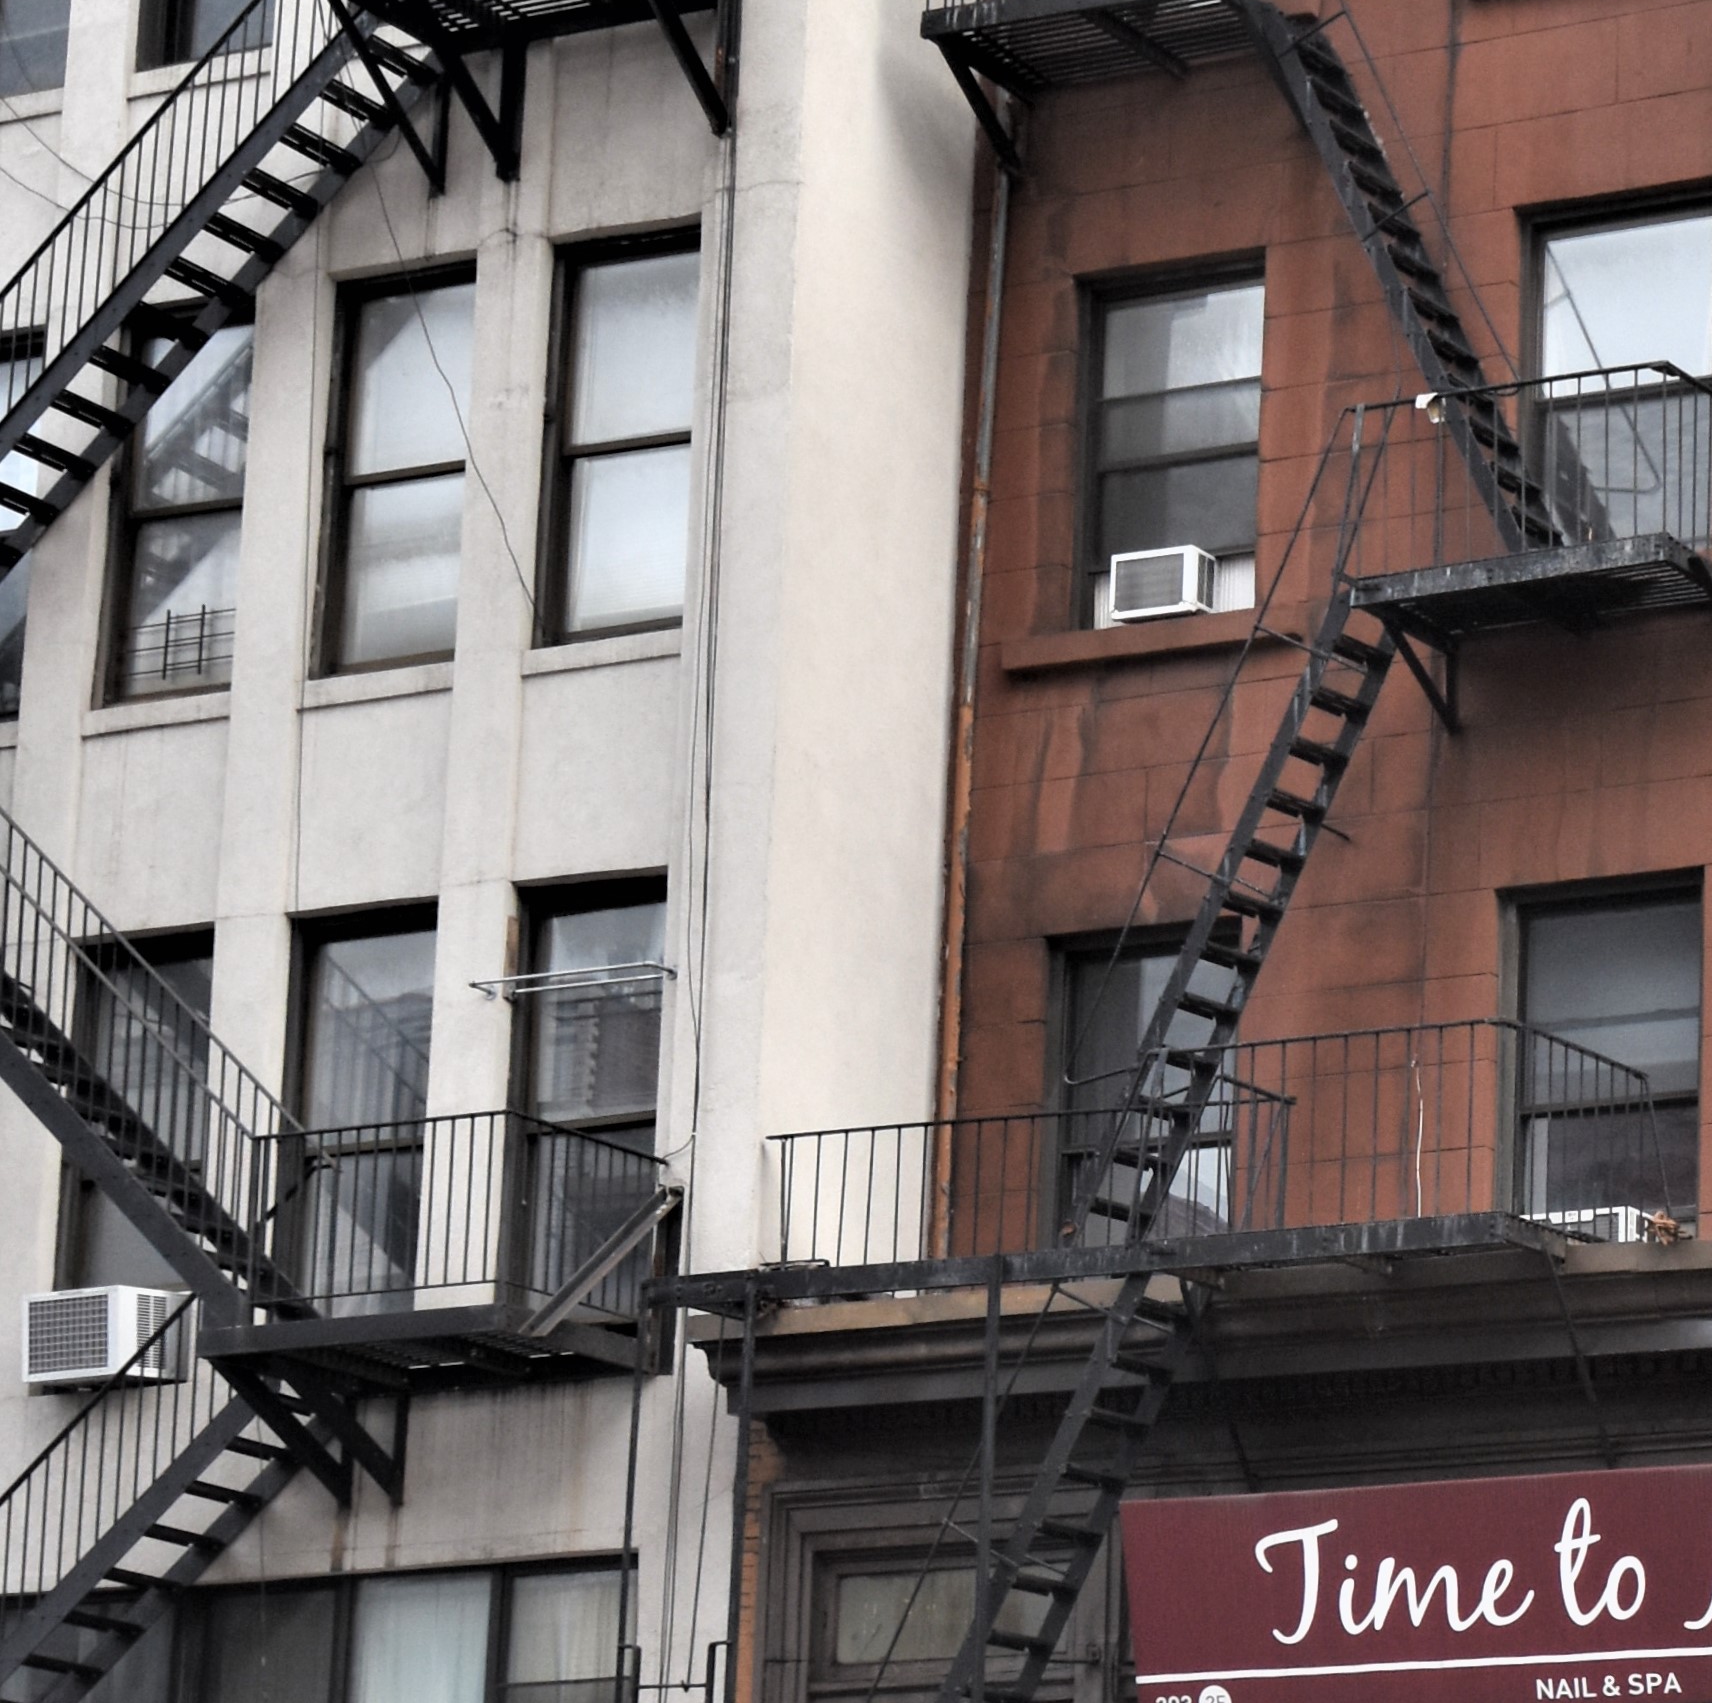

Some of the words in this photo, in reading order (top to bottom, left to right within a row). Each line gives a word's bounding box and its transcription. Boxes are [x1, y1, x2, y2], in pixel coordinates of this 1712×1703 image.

[1255, 1518, 1535, 1645] Time
[1554, 1497, 1646, 1626] to
[1536, 1676, 1598, 1700] NAIL
[1602, 1675, 1621, 1697] &
[1627, 1672, 1683, 1696] SPA
